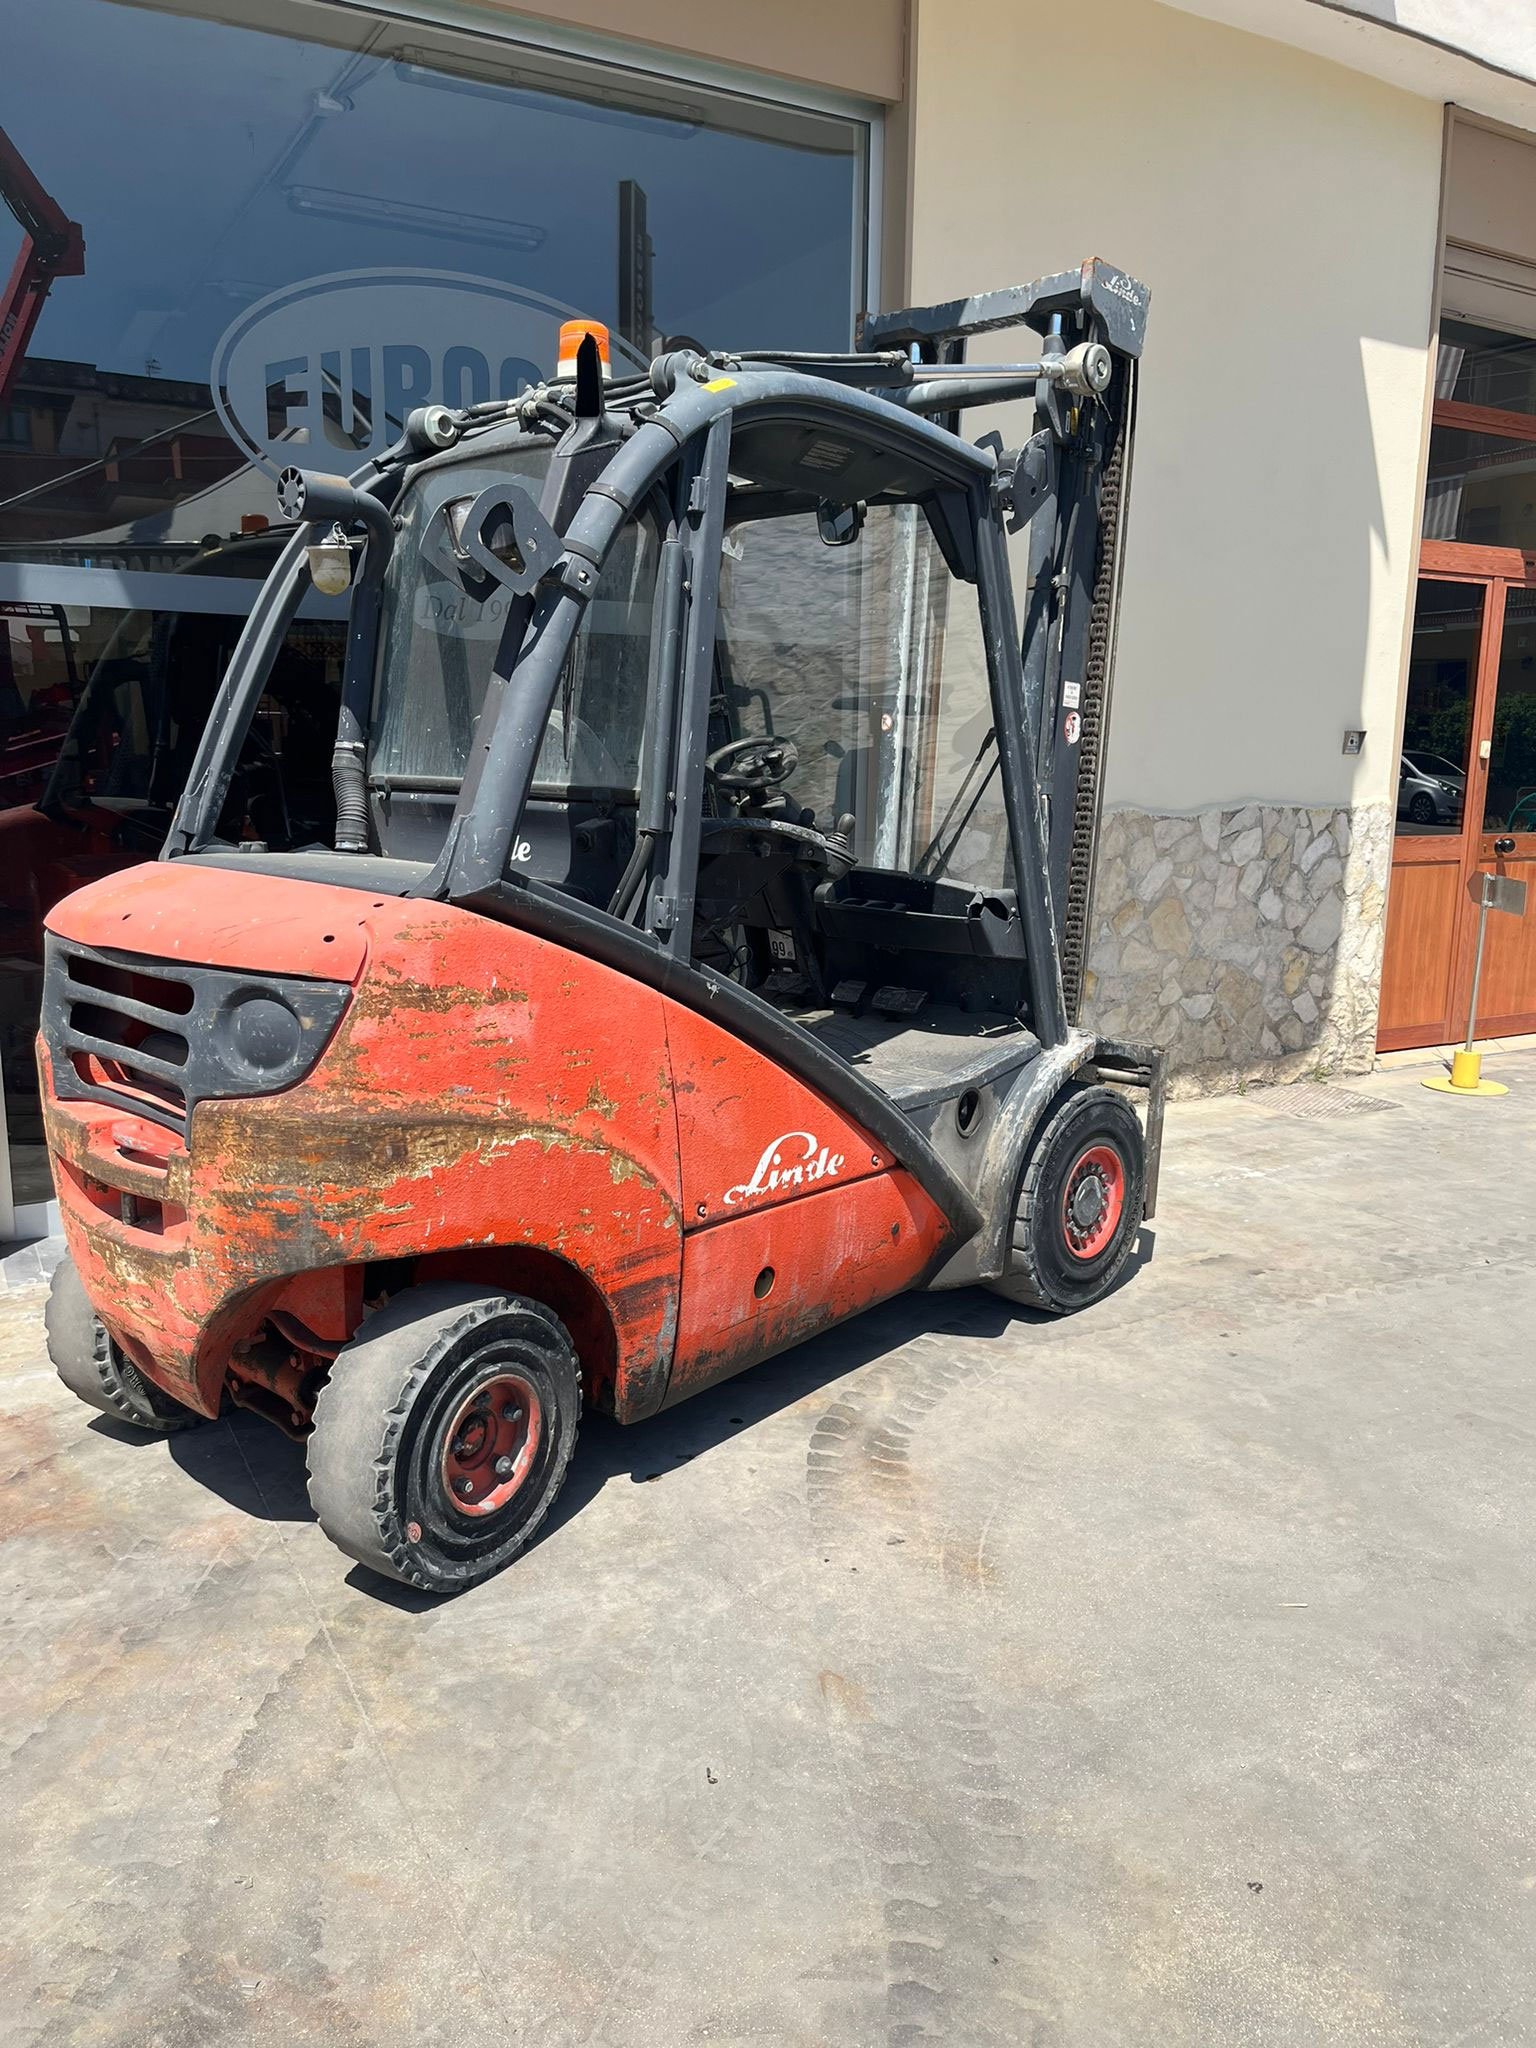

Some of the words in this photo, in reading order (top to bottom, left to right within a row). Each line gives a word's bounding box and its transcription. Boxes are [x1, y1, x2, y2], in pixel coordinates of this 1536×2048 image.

[1101, 275, 1142, 306] Linde
[421, 595, 466, 621] Dal
[772, 941, 786, 956] 99
[723, 1131, 847, 1205] Linde
